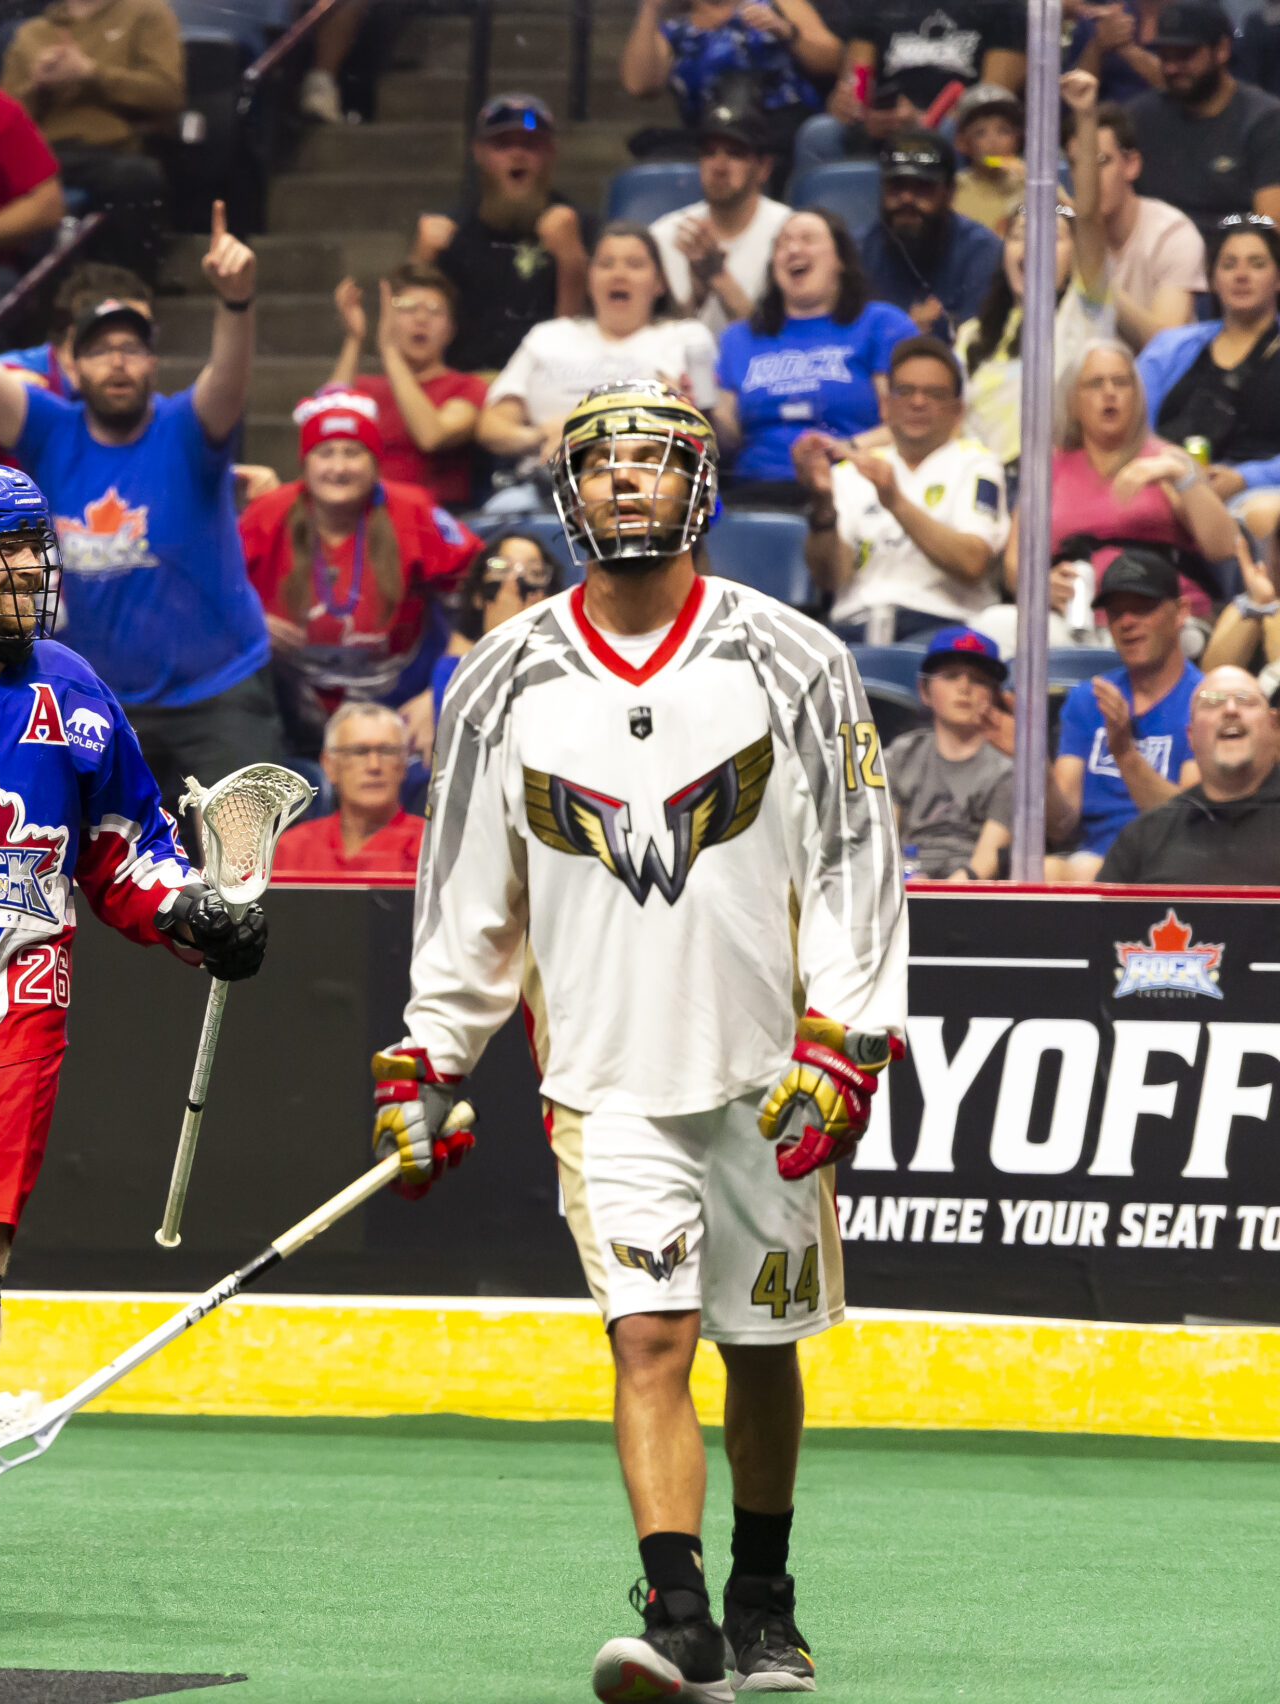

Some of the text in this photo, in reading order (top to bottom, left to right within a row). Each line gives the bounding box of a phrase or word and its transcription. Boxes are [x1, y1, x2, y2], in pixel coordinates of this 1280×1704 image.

[19, 683, 70, 746] A
[838, 722, 886, 791] 12
[14, 944, 71, 1008] 26
[1111, 952, 1224, 999] ROCK
[999, 1199, 1109, 1247] YOUR
[1118, 1202, 1227, 1249] SEAT
[751, 1242, 821, 1319] 44
